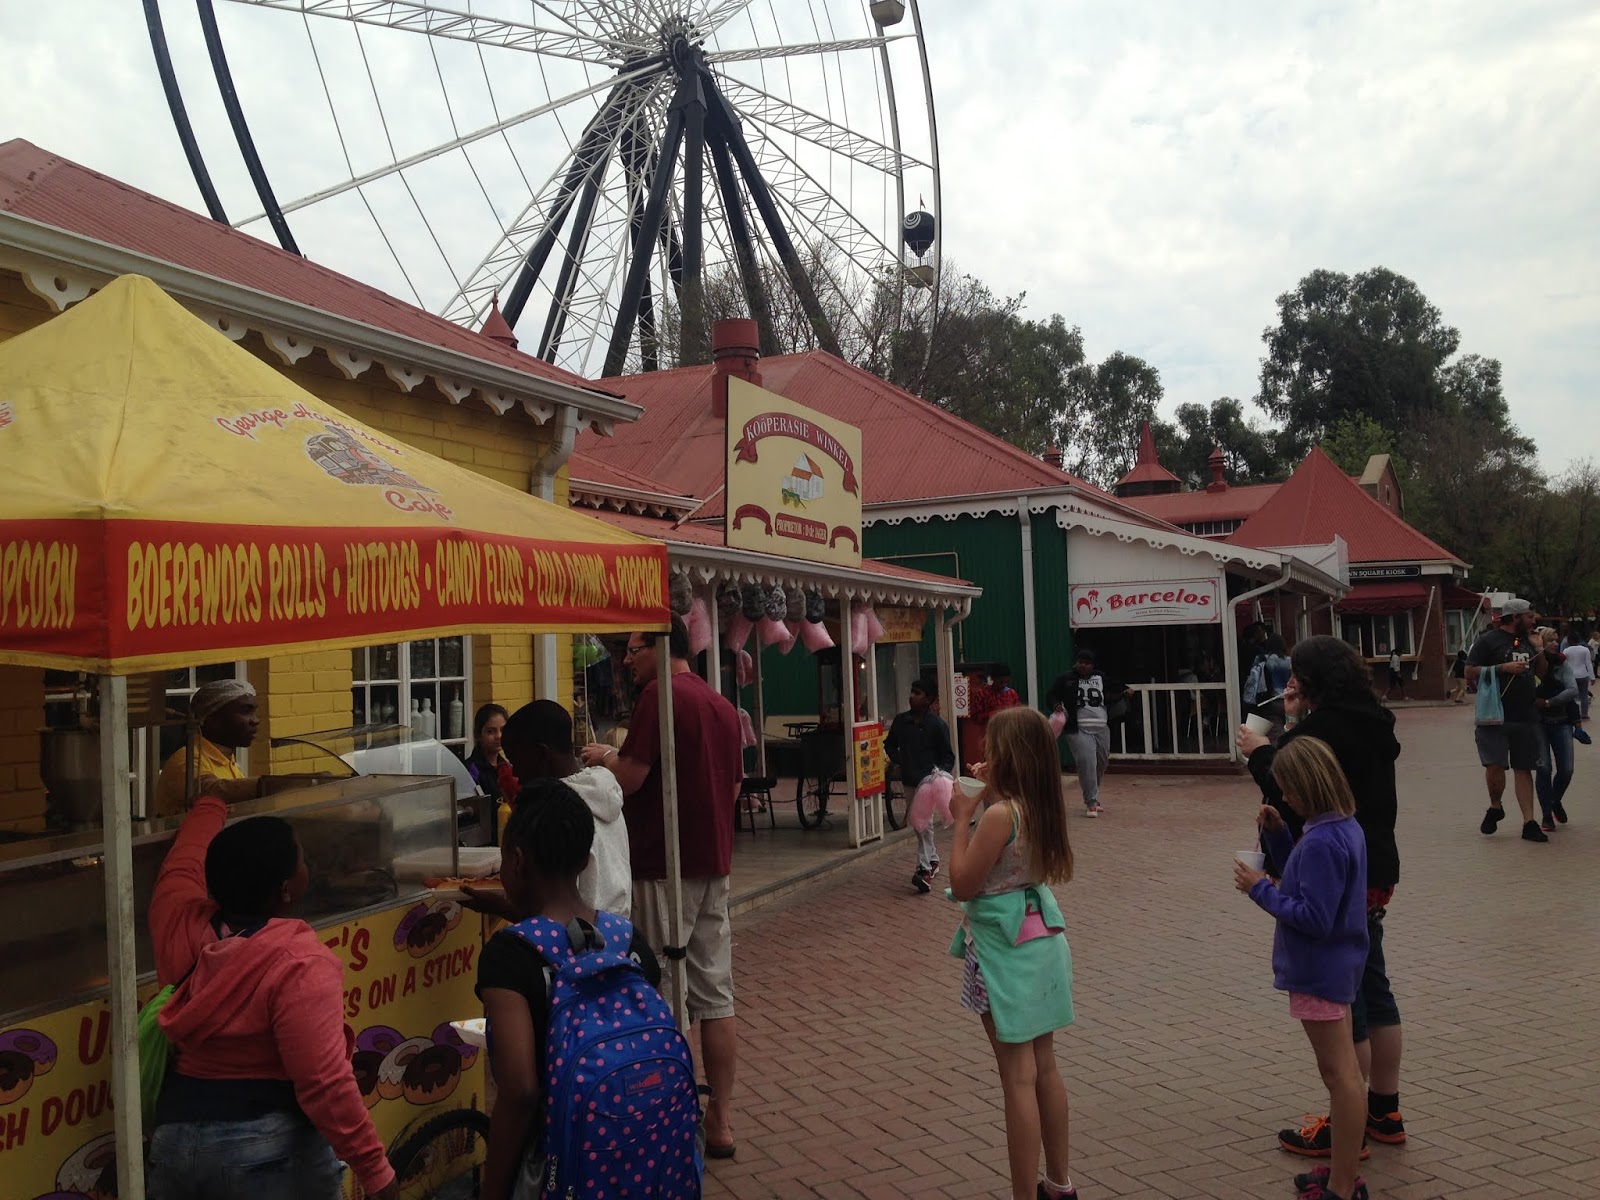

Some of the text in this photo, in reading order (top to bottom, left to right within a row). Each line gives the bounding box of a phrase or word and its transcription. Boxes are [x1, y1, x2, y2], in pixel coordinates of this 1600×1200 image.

[216, 408, 288, 440] George
[816, 430, 849, 472] WINKEL
[0, 540, 78, 629] PCORN
[127, 539, 664, 631] BOEREWORS ROLLS HOTDOGS CANDY FLOSS COLD DRINKS POPCORN
[1358, 569, 1385, 577] SQUARE
[1385, 568, 1406, 576] KIOSK
[1107, 589, 1211, 610] Barcelos
[368, 973, 398, 1010] ON
[402, 966, 416, 998] A
[422, 943, 475, 989] STICK
